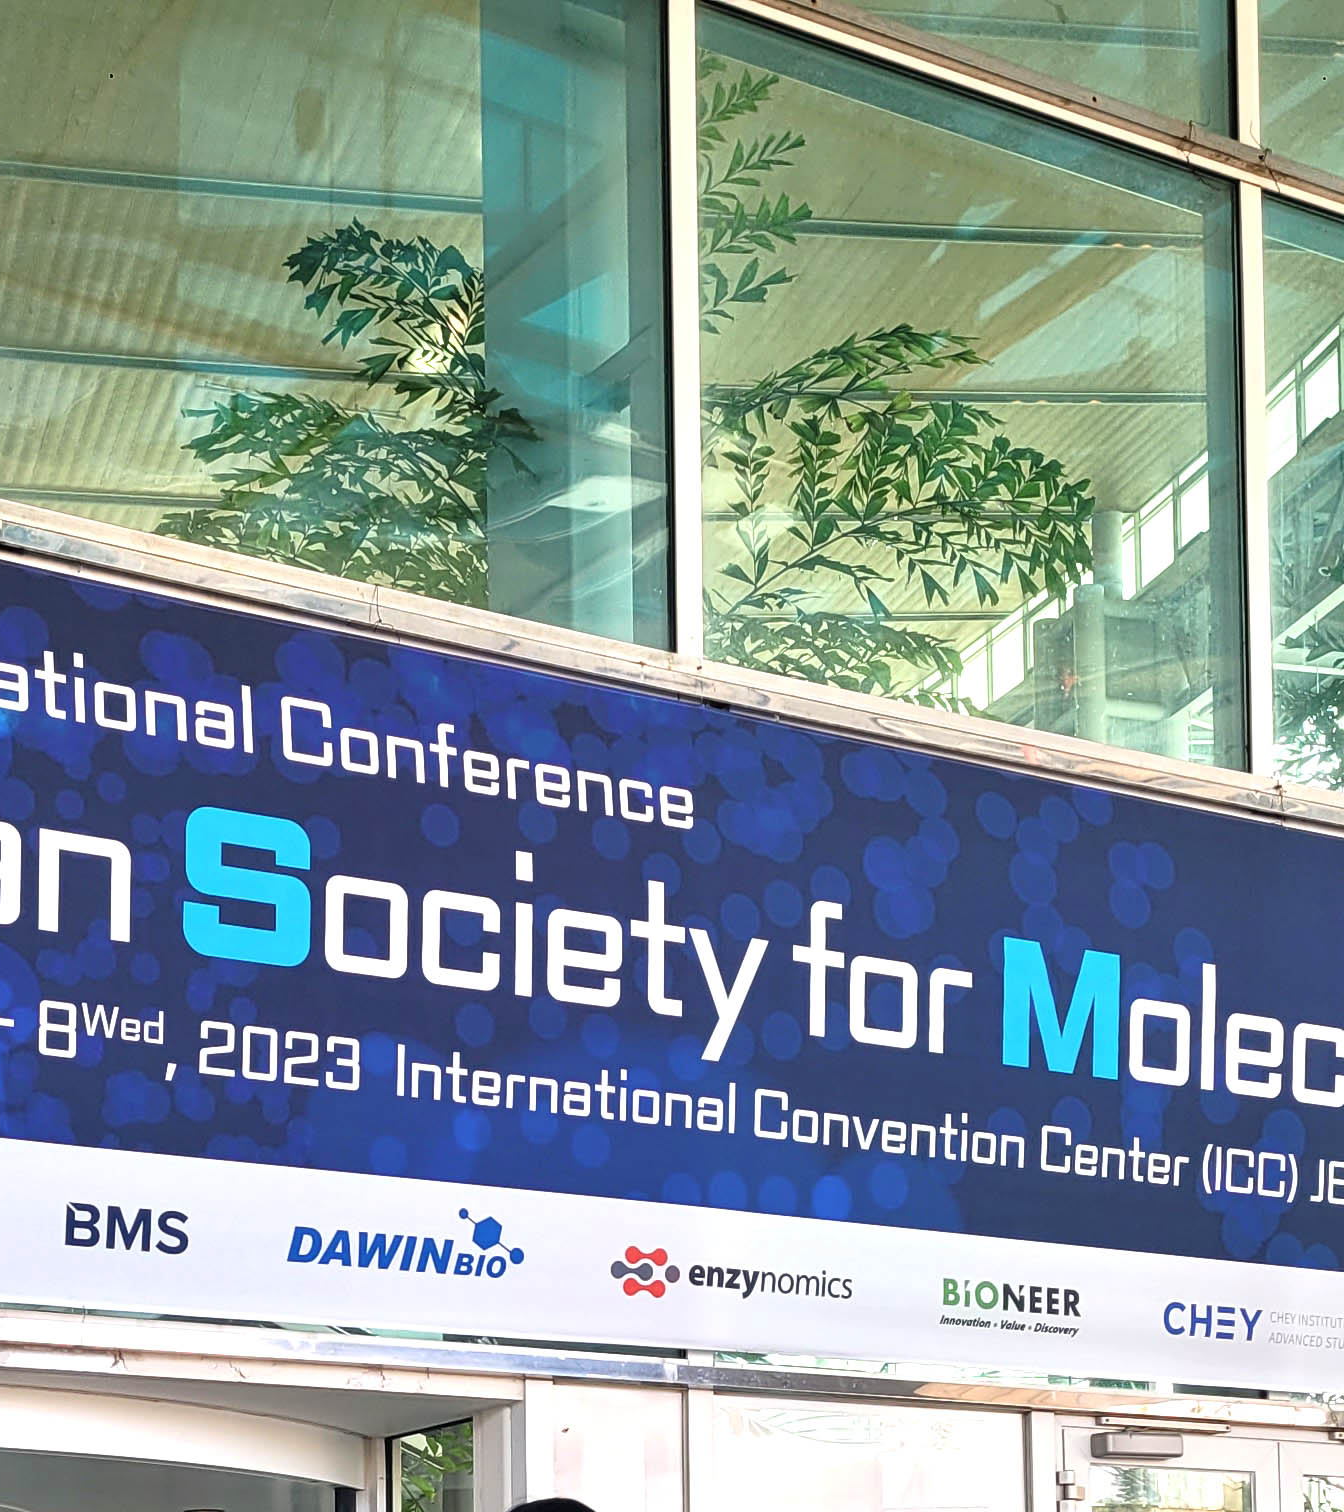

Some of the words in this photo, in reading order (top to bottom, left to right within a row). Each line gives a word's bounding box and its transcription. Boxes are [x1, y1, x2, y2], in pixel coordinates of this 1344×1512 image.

[282, 695, 695, 831] Conference
[182, 805, 769, 1062] Society
[792, 900, 973, 1056] for
[198, 1020, 361, 1091] 2023
[396, 1044, 737, 1135] International
[753, 1088, 1025, 1169] Convention
[1040, 1127, 1189, 1190] Center
[1202, 1143, 1299, 1204] (ICC)
[64, 1201, 189, 1256] BMS
[688, 1264, 854, 1301] enzynomics
[939, 1314, 991, 1329] Innovation
[999, 1319, 1027, 1333] Value
[1033, 1322, 1079, 1338] Discovery
[1163, 1302, 1263, 1341] CHEY
[1269, 1311, 1296, 1325] CHEY
[1268, 1331, 1323, 1349] ADVANCED
